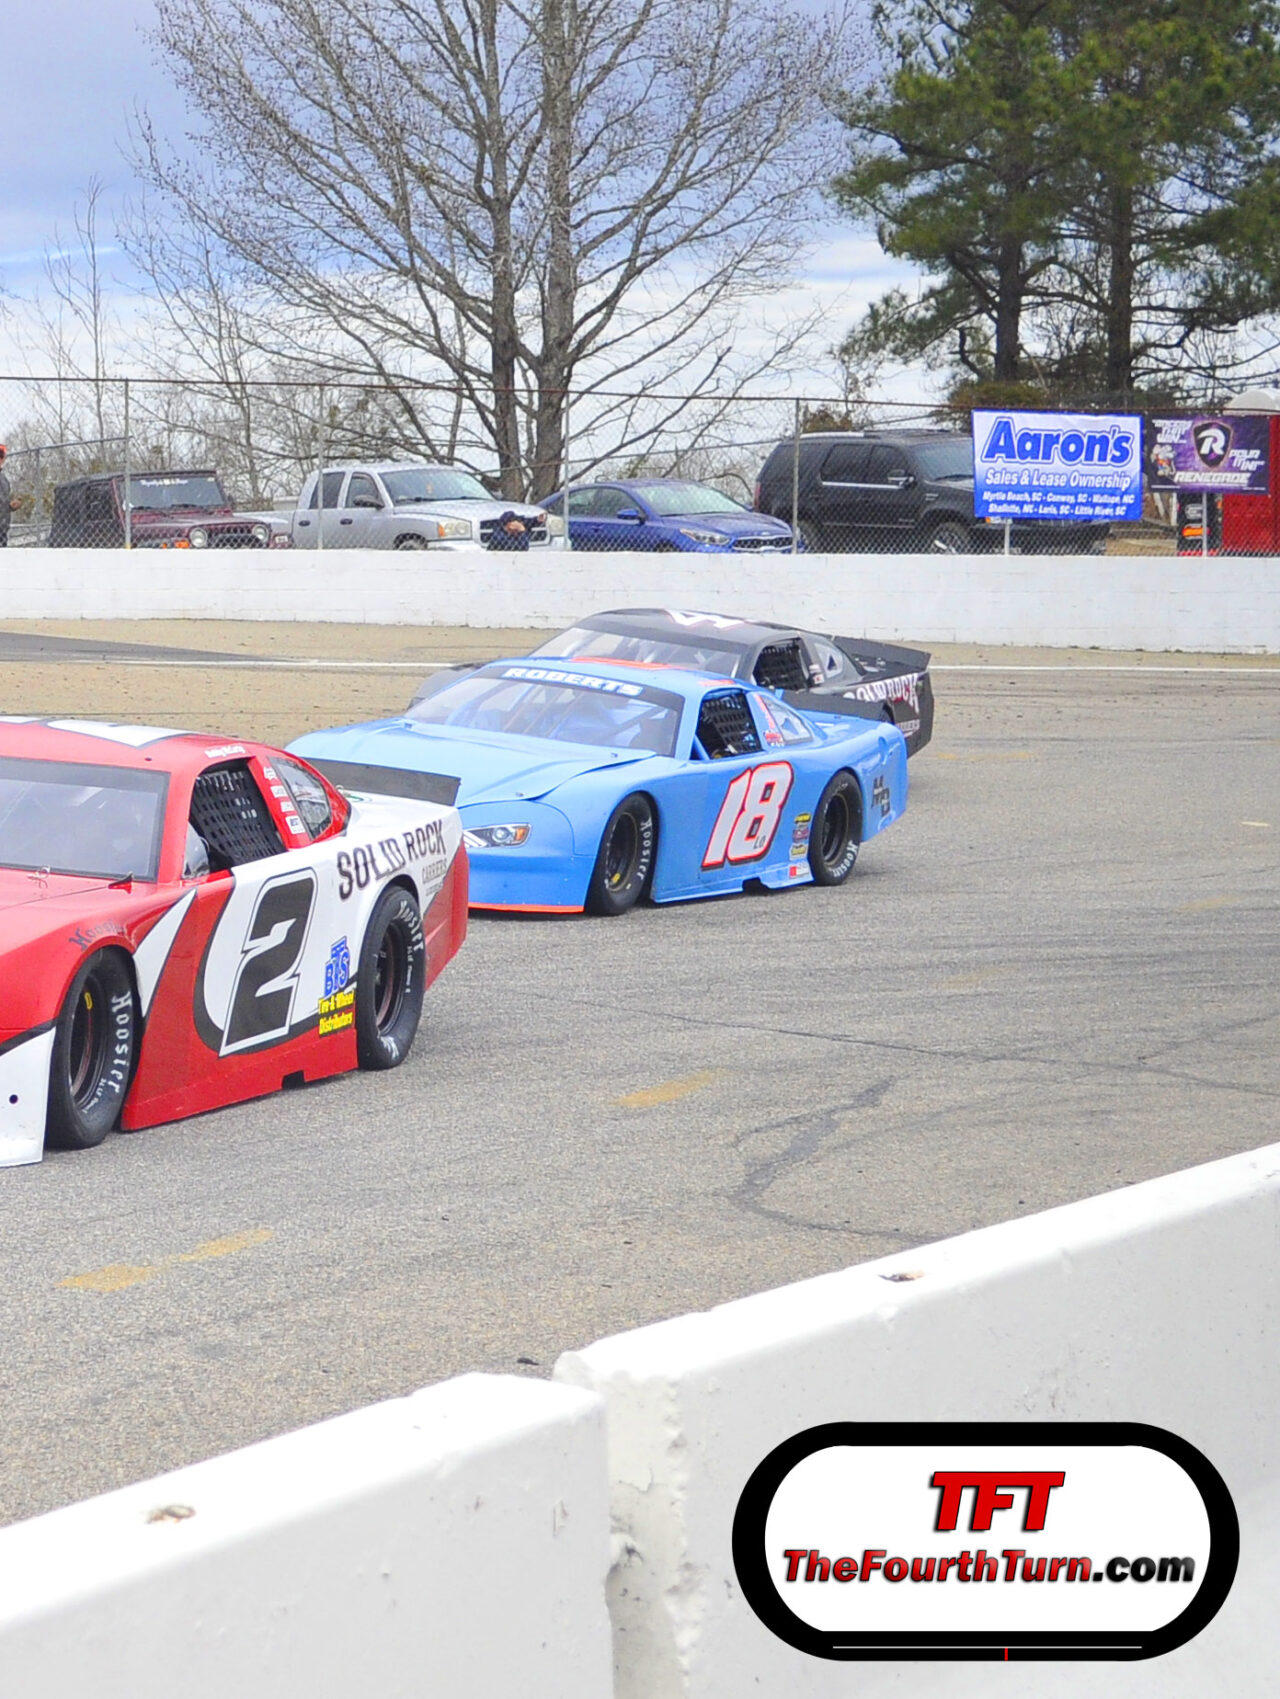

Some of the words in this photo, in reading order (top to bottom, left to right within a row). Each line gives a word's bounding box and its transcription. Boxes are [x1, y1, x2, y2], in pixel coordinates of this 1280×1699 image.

[982, 418, 1134, 466] Aaron's
[1197, 428, 1226, 455] R
[986, 468, 1018, 486] Sales
[1020, 469, 1031, 486] &
[1032, 469, 1067, 487] Lease
[1070, 471, 1131, 491] Ownership
[1173, 471, 1252, 483] RENEGADE
[502, 667, 644, 696] ROBERTS
[700, 760, 794, 870] 18
[337, 838, 406, 901] SOLID
[402, 819, 447, 861] ROCK
[220, 868, 318, 1056] 2
[111, 991, 134, 1094] Hoosier
